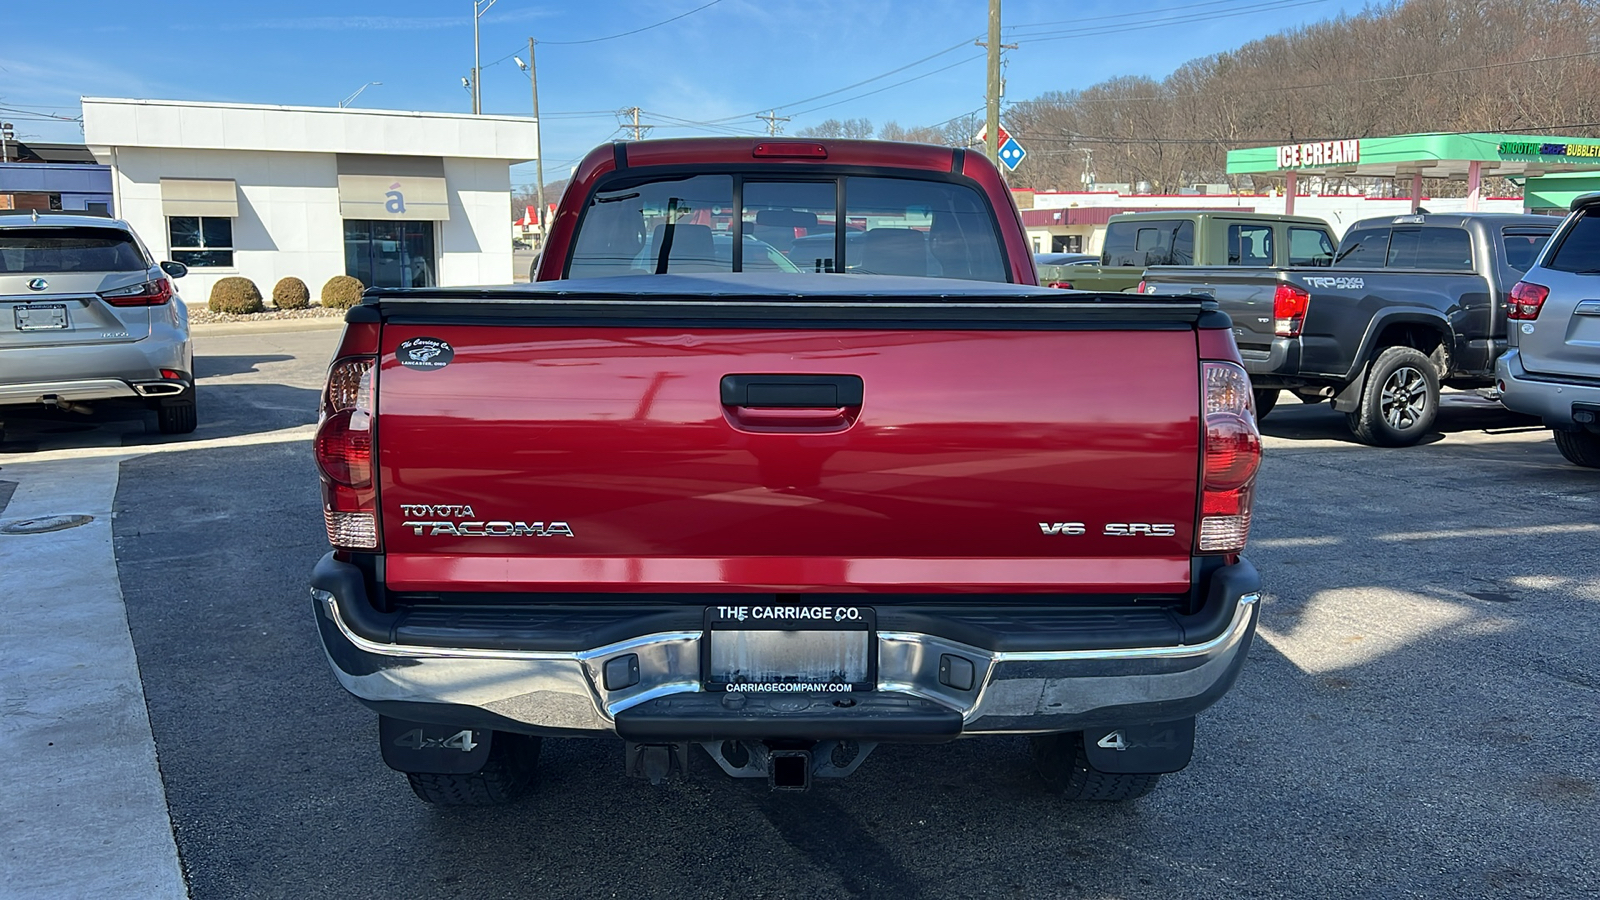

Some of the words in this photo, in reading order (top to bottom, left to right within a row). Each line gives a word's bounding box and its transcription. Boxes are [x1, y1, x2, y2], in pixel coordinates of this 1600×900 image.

[1276, 145, 1302, 168] ICE
[1302, 139, 1360, 166] CREAM
[1302, 276, 1337, 289] TRD
[400, 504, 476, 518] TOYOTA
[401, 521, 575, 538] TACOMA
[1038, 522, 1086, 535] V6
[717, 606, 749, 619] THE
[752, 606, 833, 620] CARRIAGE
[835, 606, 863, 620] CO.
[725, 683, 853, 693] CARRIAGECOMPANY.COM
